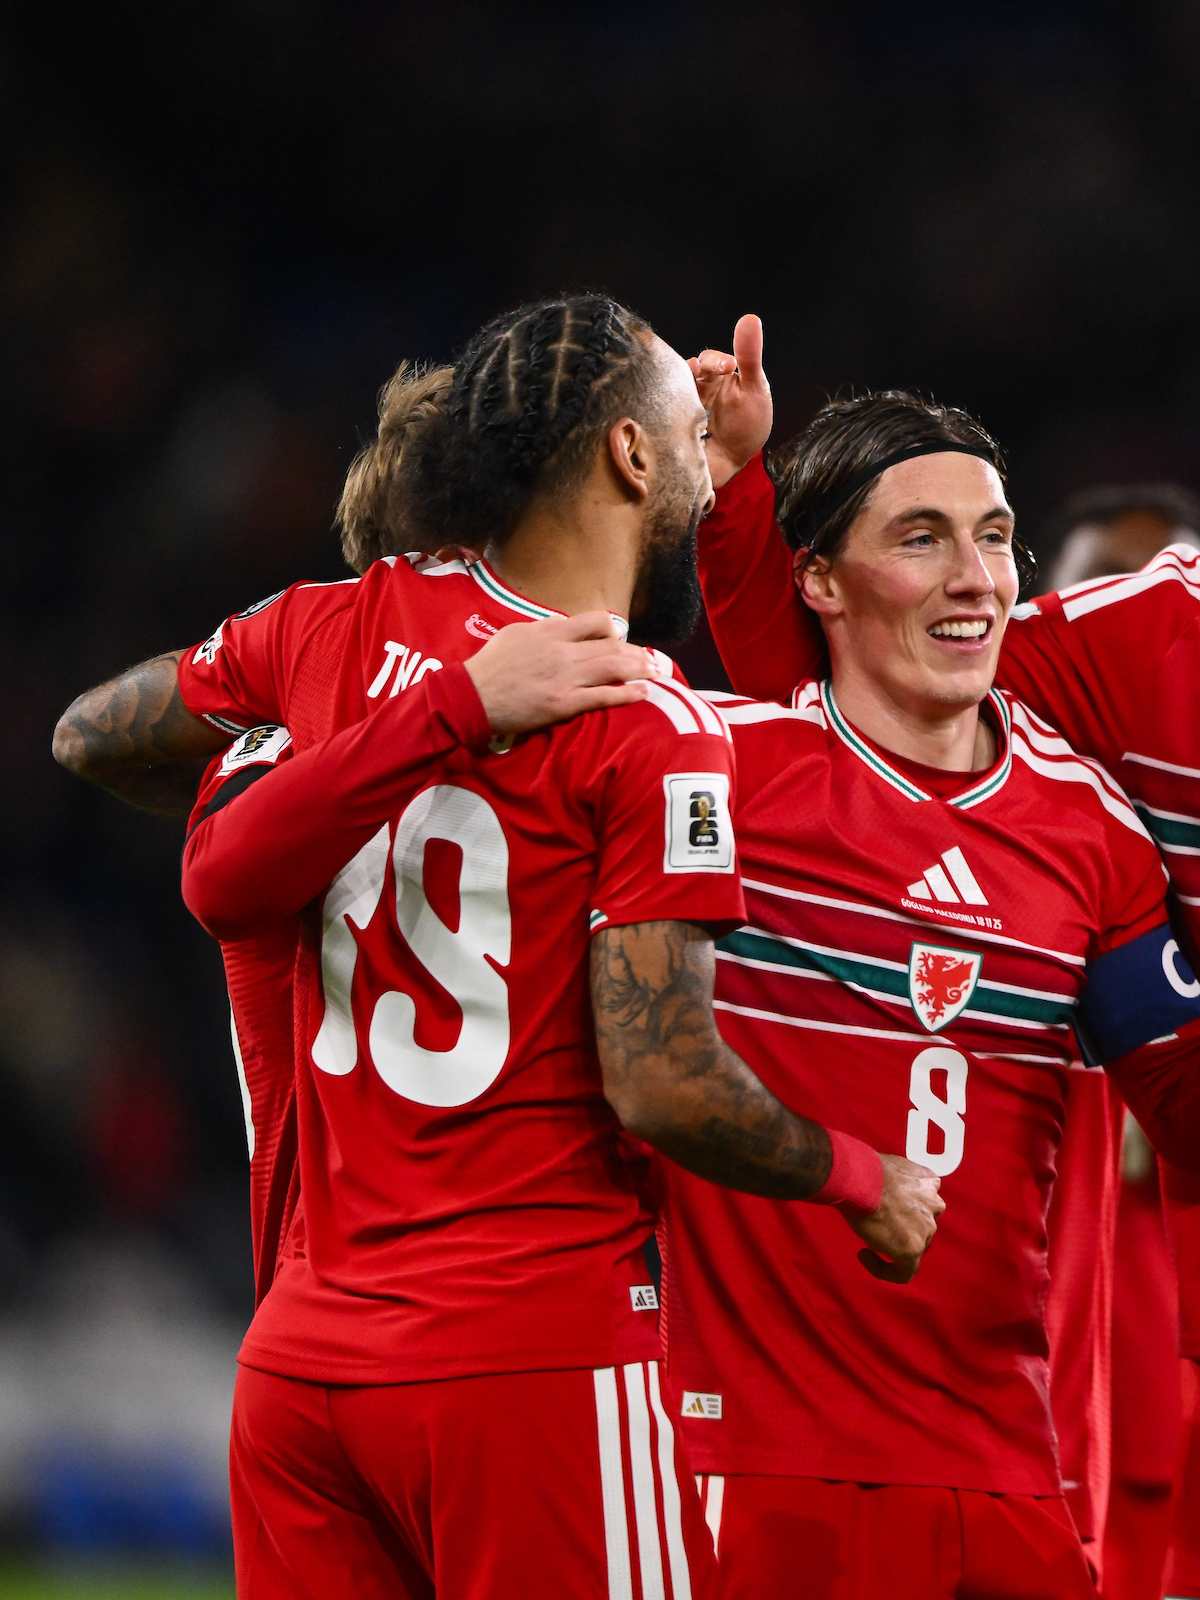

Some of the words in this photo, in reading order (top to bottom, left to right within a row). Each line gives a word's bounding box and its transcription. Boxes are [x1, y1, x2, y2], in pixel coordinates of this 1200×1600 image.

[311, 784, 512, 1107] 19
[976, 916, 986, 927] 18
[985, 917, 993, 928] 11
[993, 919, 1003, 930] 25
[906, 1047, 968, 1177] 8
